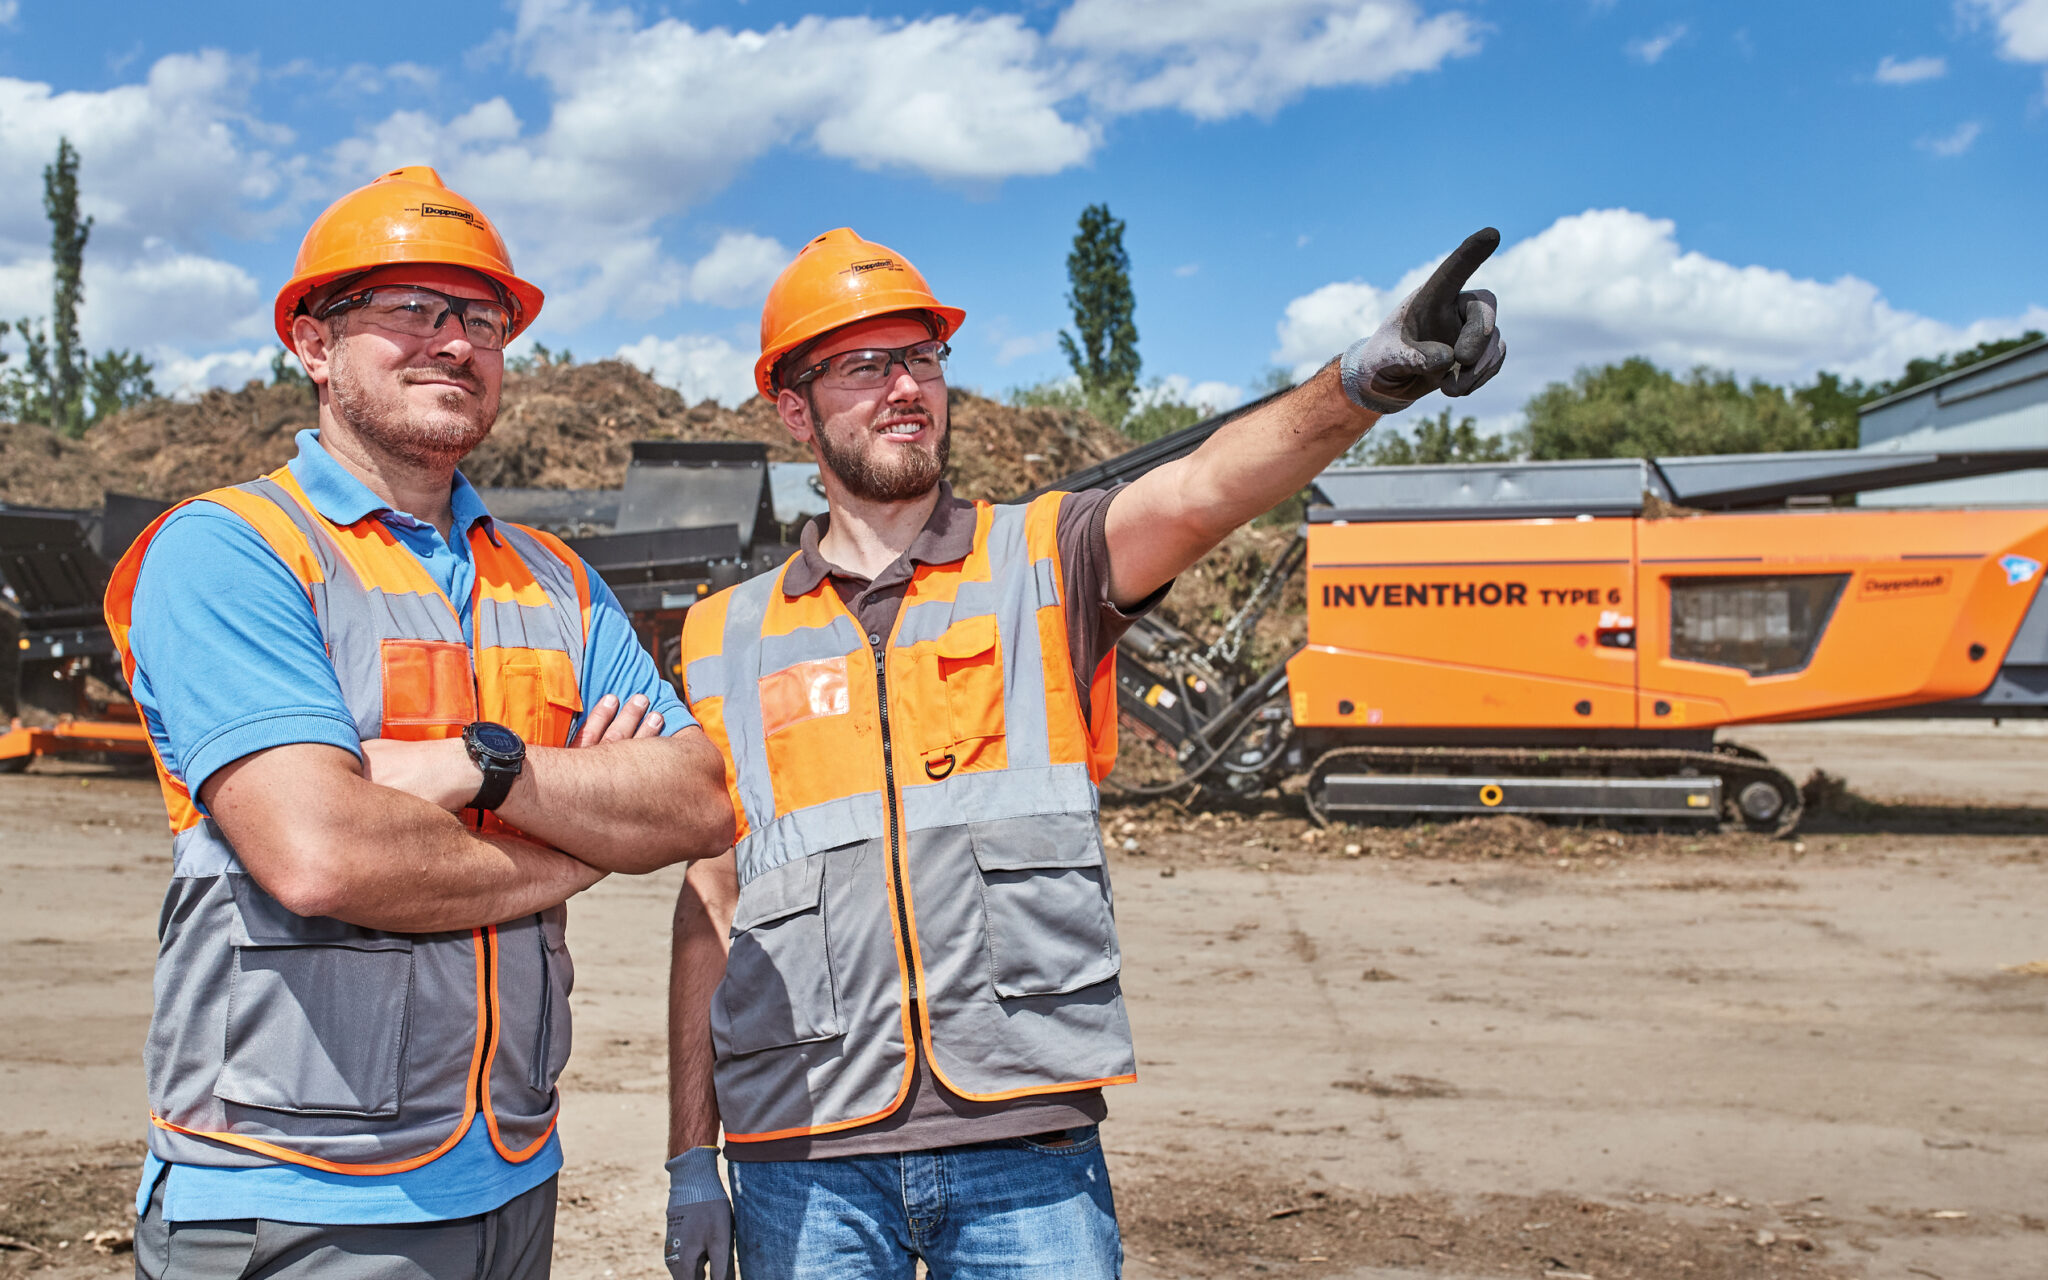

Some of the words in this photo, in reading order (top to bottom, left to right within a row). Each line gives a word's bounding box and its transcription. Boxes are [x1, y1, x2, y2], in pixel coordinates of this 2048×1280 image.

[424, 206, 471, 220] Doppstadt
[1323, 583, 1527, 607] INVENTHOR
[1539, 588, 1600, 605] TYPE
[1607, 587, 1621, 605] 6
